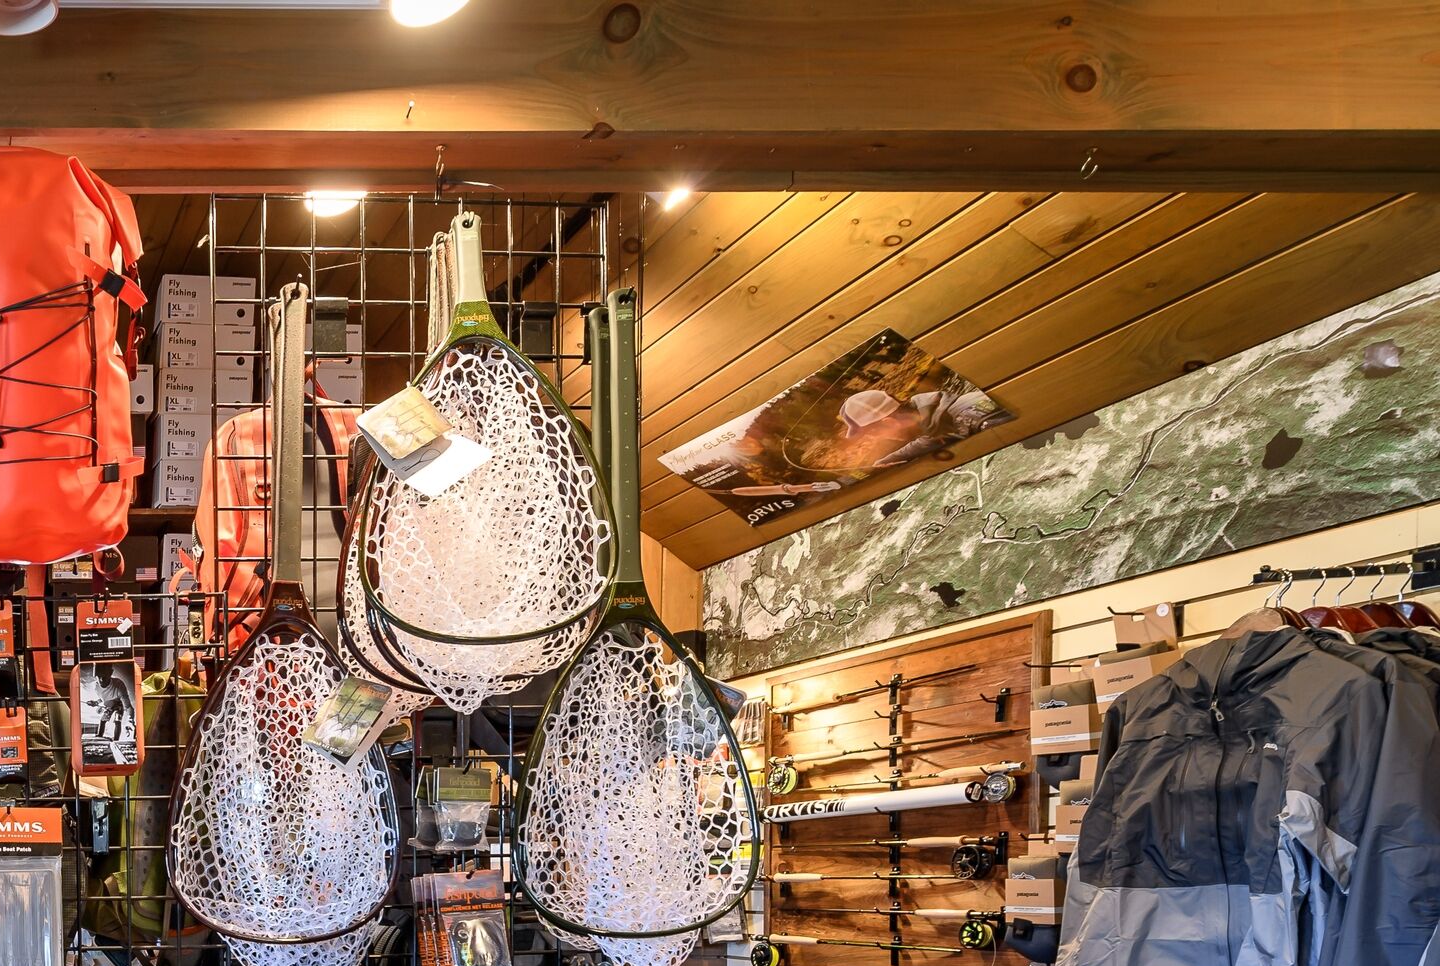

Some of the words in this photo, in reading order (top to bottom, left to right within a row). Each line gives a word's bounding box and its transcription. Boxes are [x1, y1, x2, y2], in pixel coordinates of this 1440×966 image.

[169, 280, 180, 288] Fly
[168, 289, 197, 298] Fishing
[169, 328, 181, 336] Fly
[168, 337, 197, 346] Fishing
[166, 374, 177, 382] Fly
[166, 383, 194, 392] Fishing
[168, 420, 179, 428] Fly
[168, 428, 195, 437] Fishing
[703, 431, 736, 450] GLASS
[167, 465, 178, 473] Fly
[167, 474, 195, 482] Fishing
[747, 500, 795, 523] ORVIS
[171, 539, 182, 547] Fly
[85, 617, 124, 625] SIMMS
[1107, 674, 1134, 684] patagonia
[1045, 719, 1072, 727] patagonia
[764, 799, 827, 819] ORVIS
[446, 885, 497, 904] fishpond
